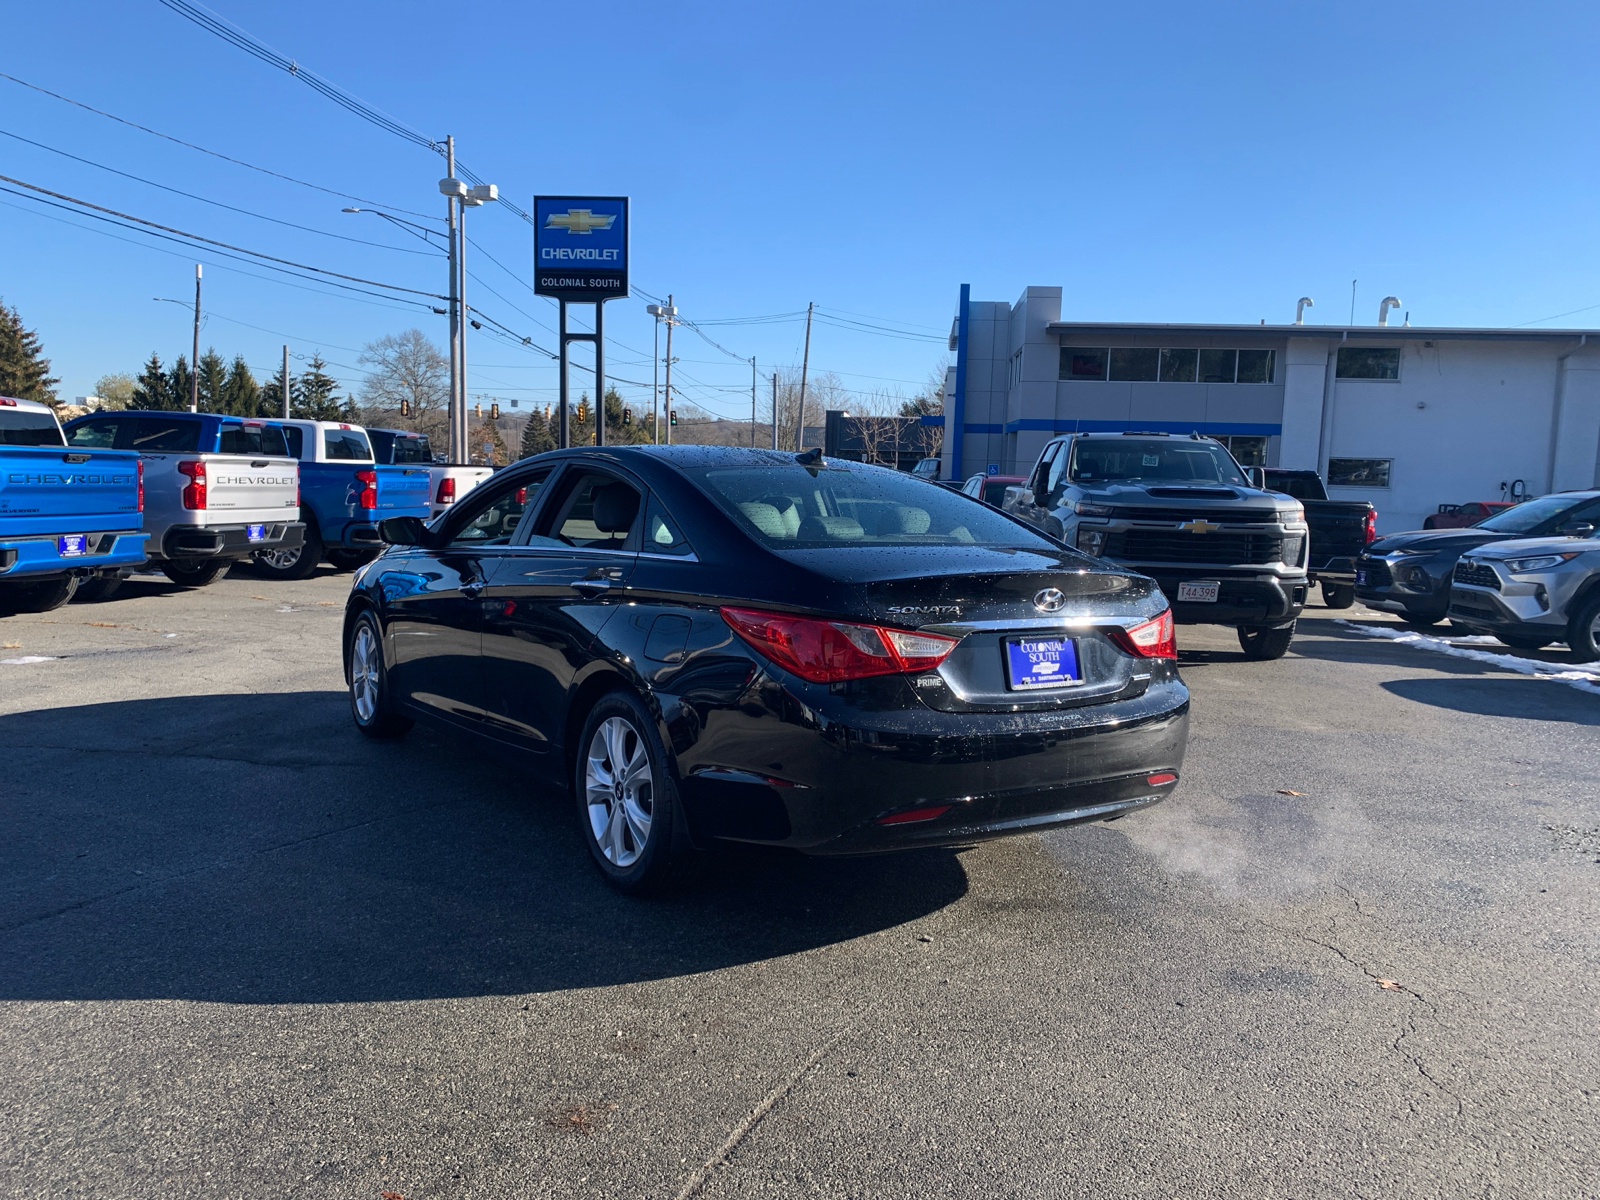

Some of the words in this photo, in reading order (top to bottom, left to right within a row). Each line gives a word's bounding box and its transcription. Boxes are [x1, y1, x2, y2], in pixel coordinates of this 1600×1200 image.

[541, 247, 620, 261] CHEVROLET
[541, 277, 587, 287] COLONIAL
[589, 278, 620, 288] SOUTH
[1143, 456, 1157, 466] 585
[8, 474, 135, 485] CHEVROLET
[216, 476, 295, 485] CHEVROLET
[1180, 586, 1216, 598] T44-398
[885, 605, 961, 615] SONATA
[1021, 641, 1065, 653] COLONIAL
[1028, 651, 1060, 663] SOUTH
[916, 678, 942, 687] PRIME
[1039, 714, 1082, 723] SONATA
